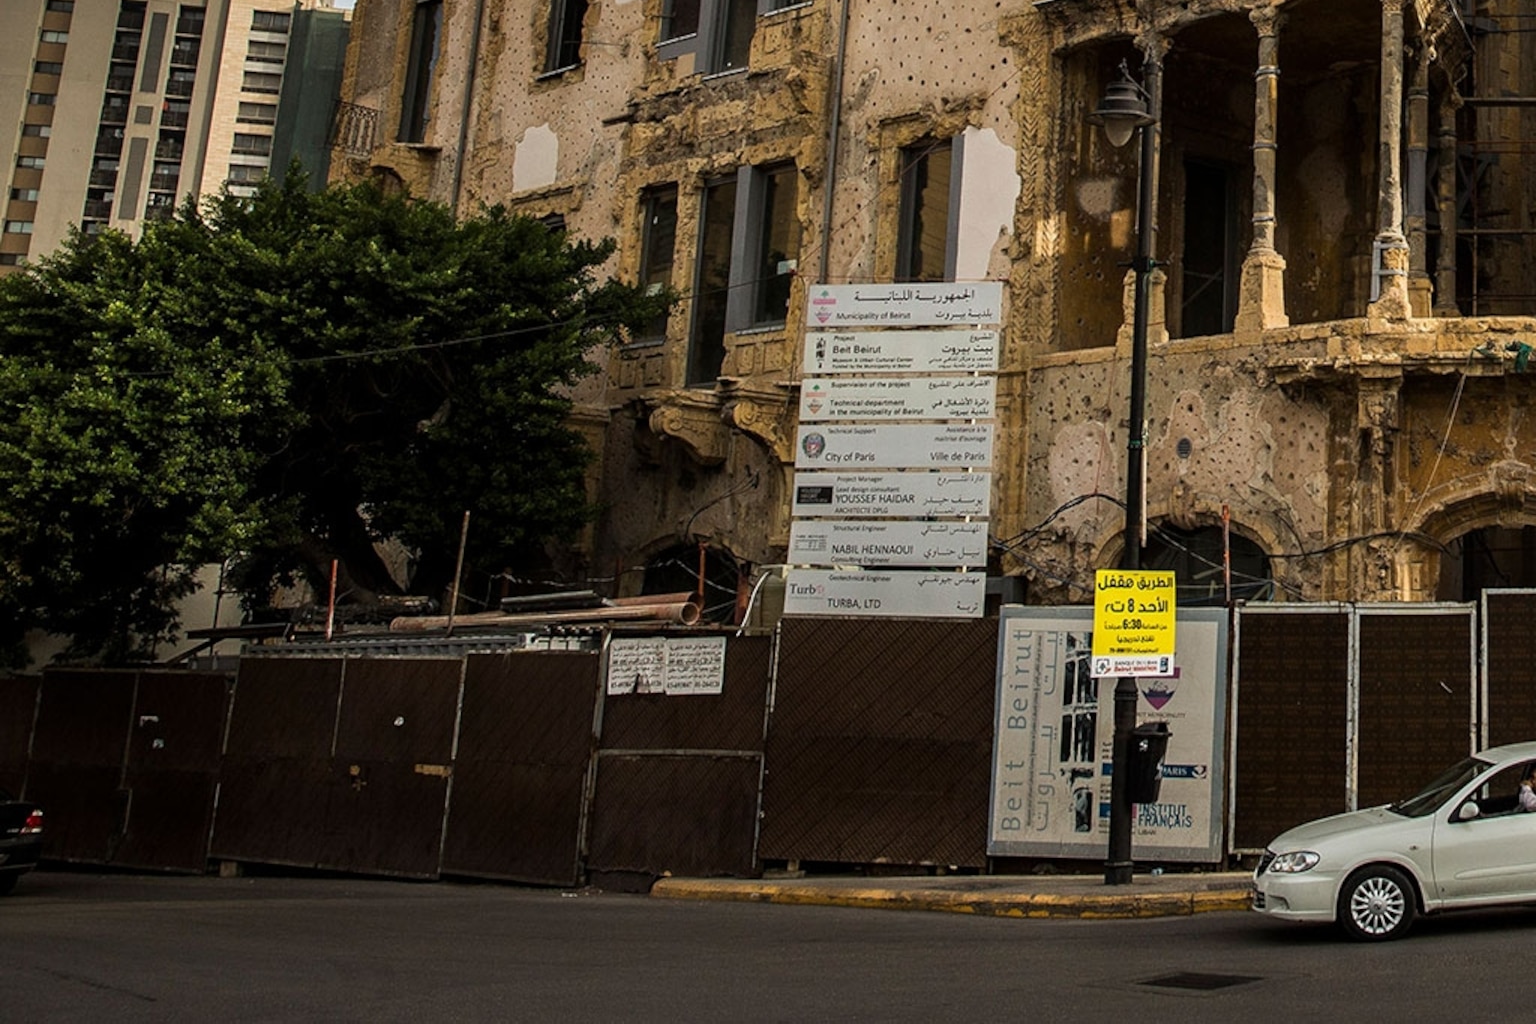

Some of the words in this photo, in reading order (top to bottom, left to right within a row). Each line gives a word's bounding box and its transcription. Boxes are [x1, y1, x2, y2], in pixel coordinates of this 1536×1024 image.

[854, 289, 913, 304] اللبنانية
[915, 288, 974, 304] الجمهورية
[836, 312, 878, 320] Municipality
[936, 311, 966, 321] بيروت
[968, 308, 992, 319] بلدية
[833, 346, 851, 354] Beit
[853, 345, 882, 354] Beirut
[942, 345, 971, 356] بيروت
[974, 345, 993, 355] بيت
[864, 399, 905, 407] department
[825, 452, 841, 463] City
[843, 451, 853, 461] of
[854, 452, 875, 461] Paris
[930, 452, 949, 461] Ville
[951, 452, 962, 461] de
[964, 452, 985, 461] Paris
[836, 494, 876, 504] YOUSSEF
[878, 494, 915, 503] HAIDAR
[832, 544, 859, 554] NABIL
[861, 545, 914, 554] HENNAOUI
[1098, 574, 1135, 591] مقفل
[1136, 576, 1174, 591] الطريق
[827, 598, 862, 609] TURBA,
[864, 599, 882, 609] LTD
[1127, 598, 1135, 613] 8
[1137, 596, 1168, 613] الأحد
[1122, 618, 1142, 630] 6:30
[1007, 630, 1033, 730] Beirut
[1001, 760, 1025, 831] Beit
[1139, 805, 1187, 816] INSTITUT
